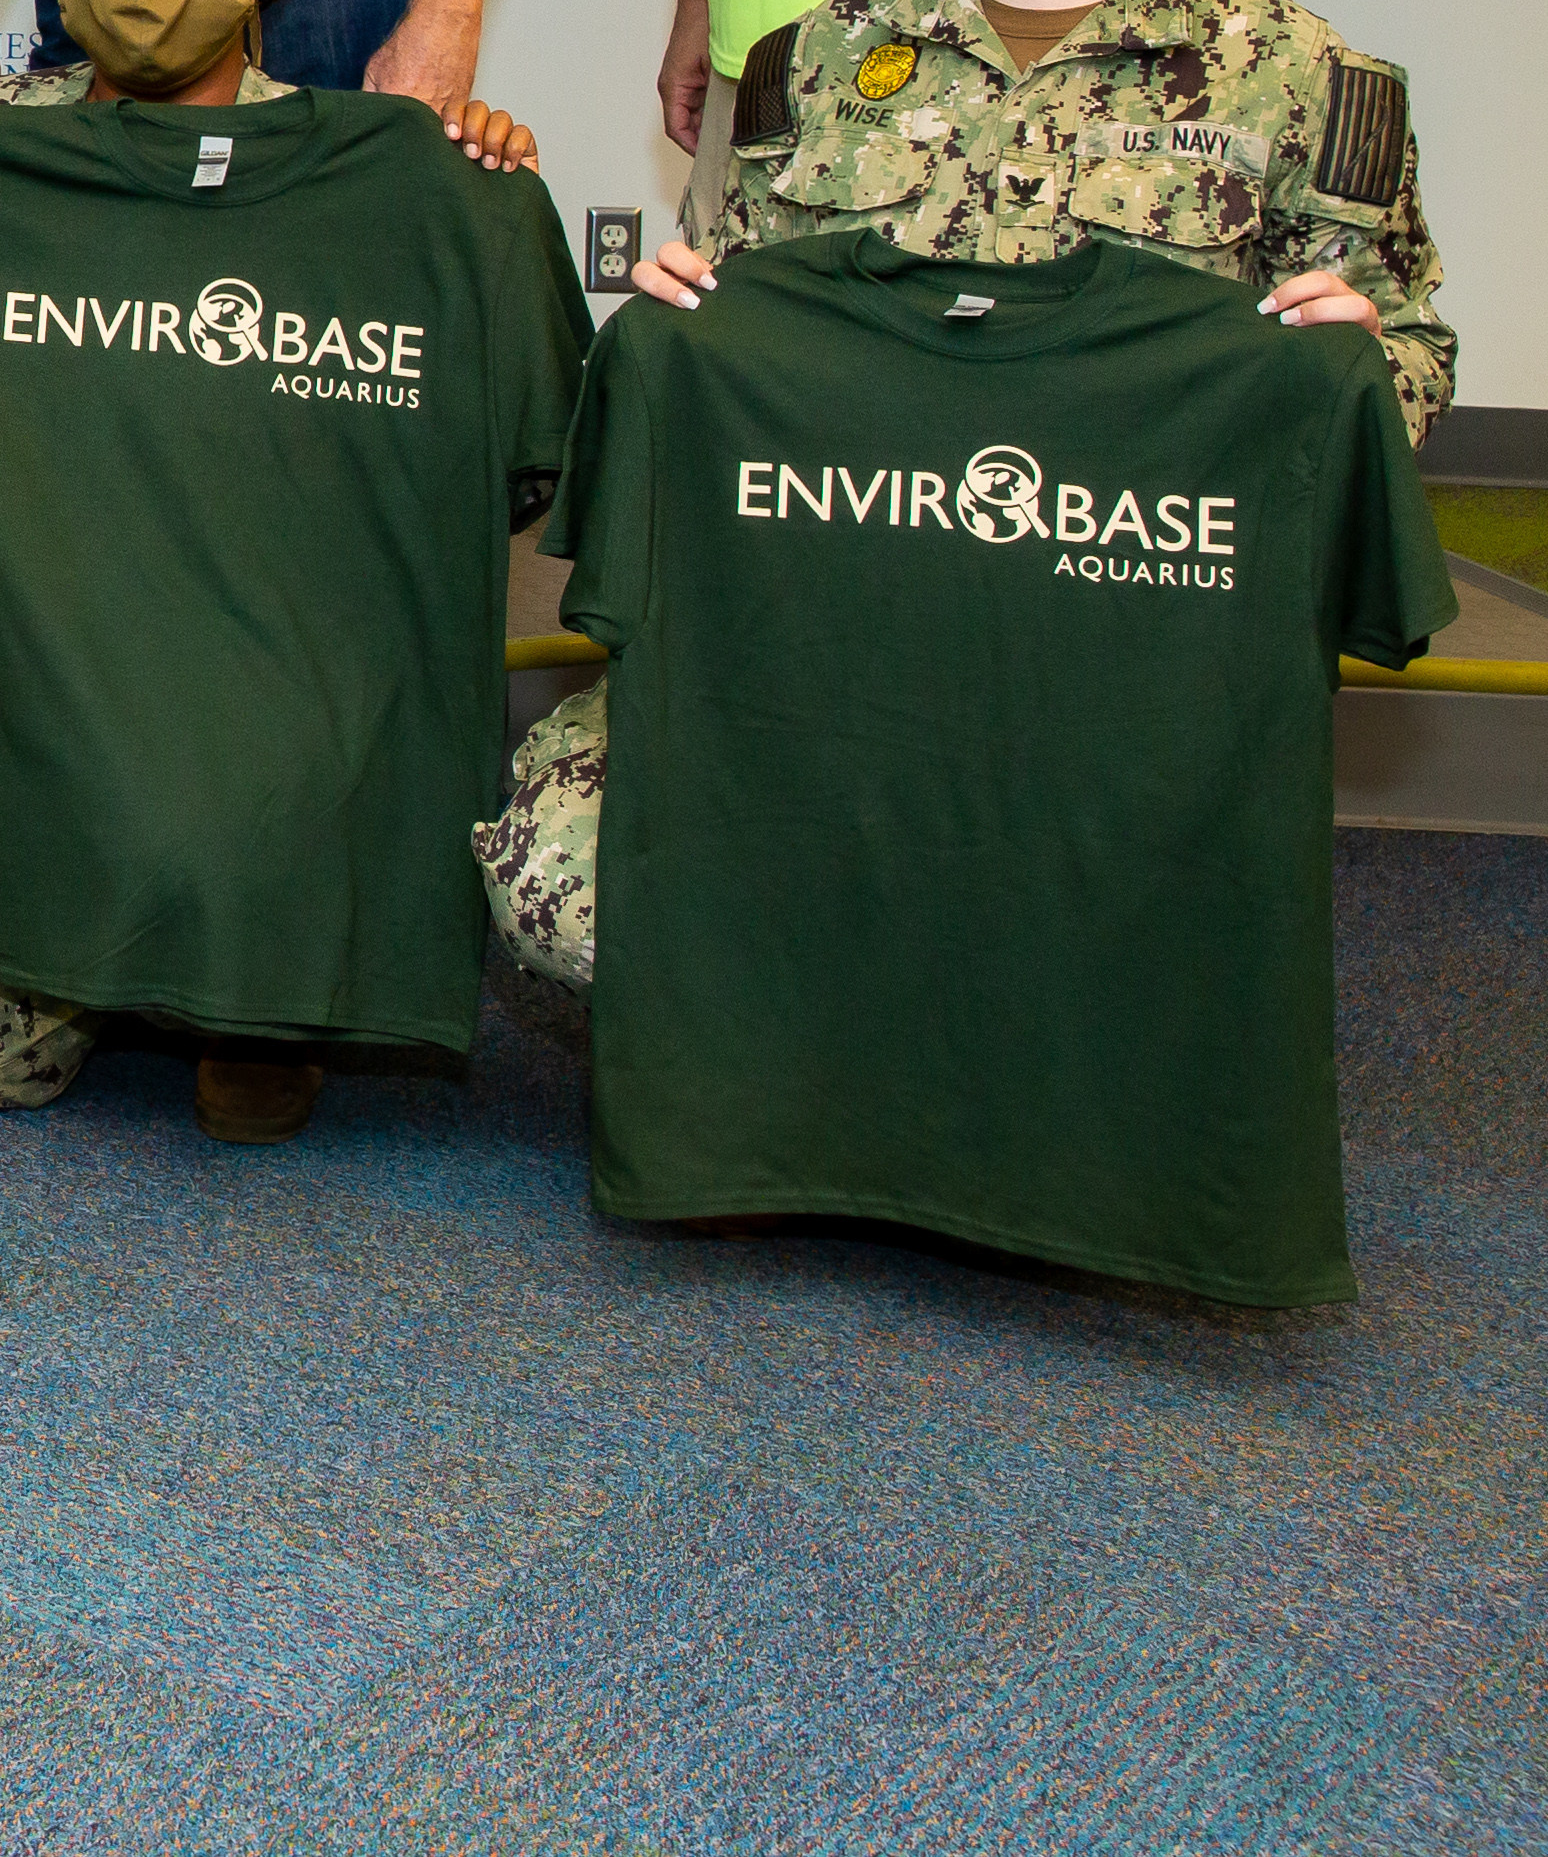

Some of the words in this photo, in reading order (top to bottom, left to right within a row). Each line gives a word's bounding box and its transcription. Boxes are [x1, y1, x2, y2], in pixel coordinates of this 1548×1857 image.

[835, 98, 894, 128] WISE
[1121, 130, 1162, 153] U.S.
[1172, 127, 1231, 160] NAVY
[270, 373, 420, 409] AQUARIUS
[1054, 553, 1235, 591] AQUARIUS
